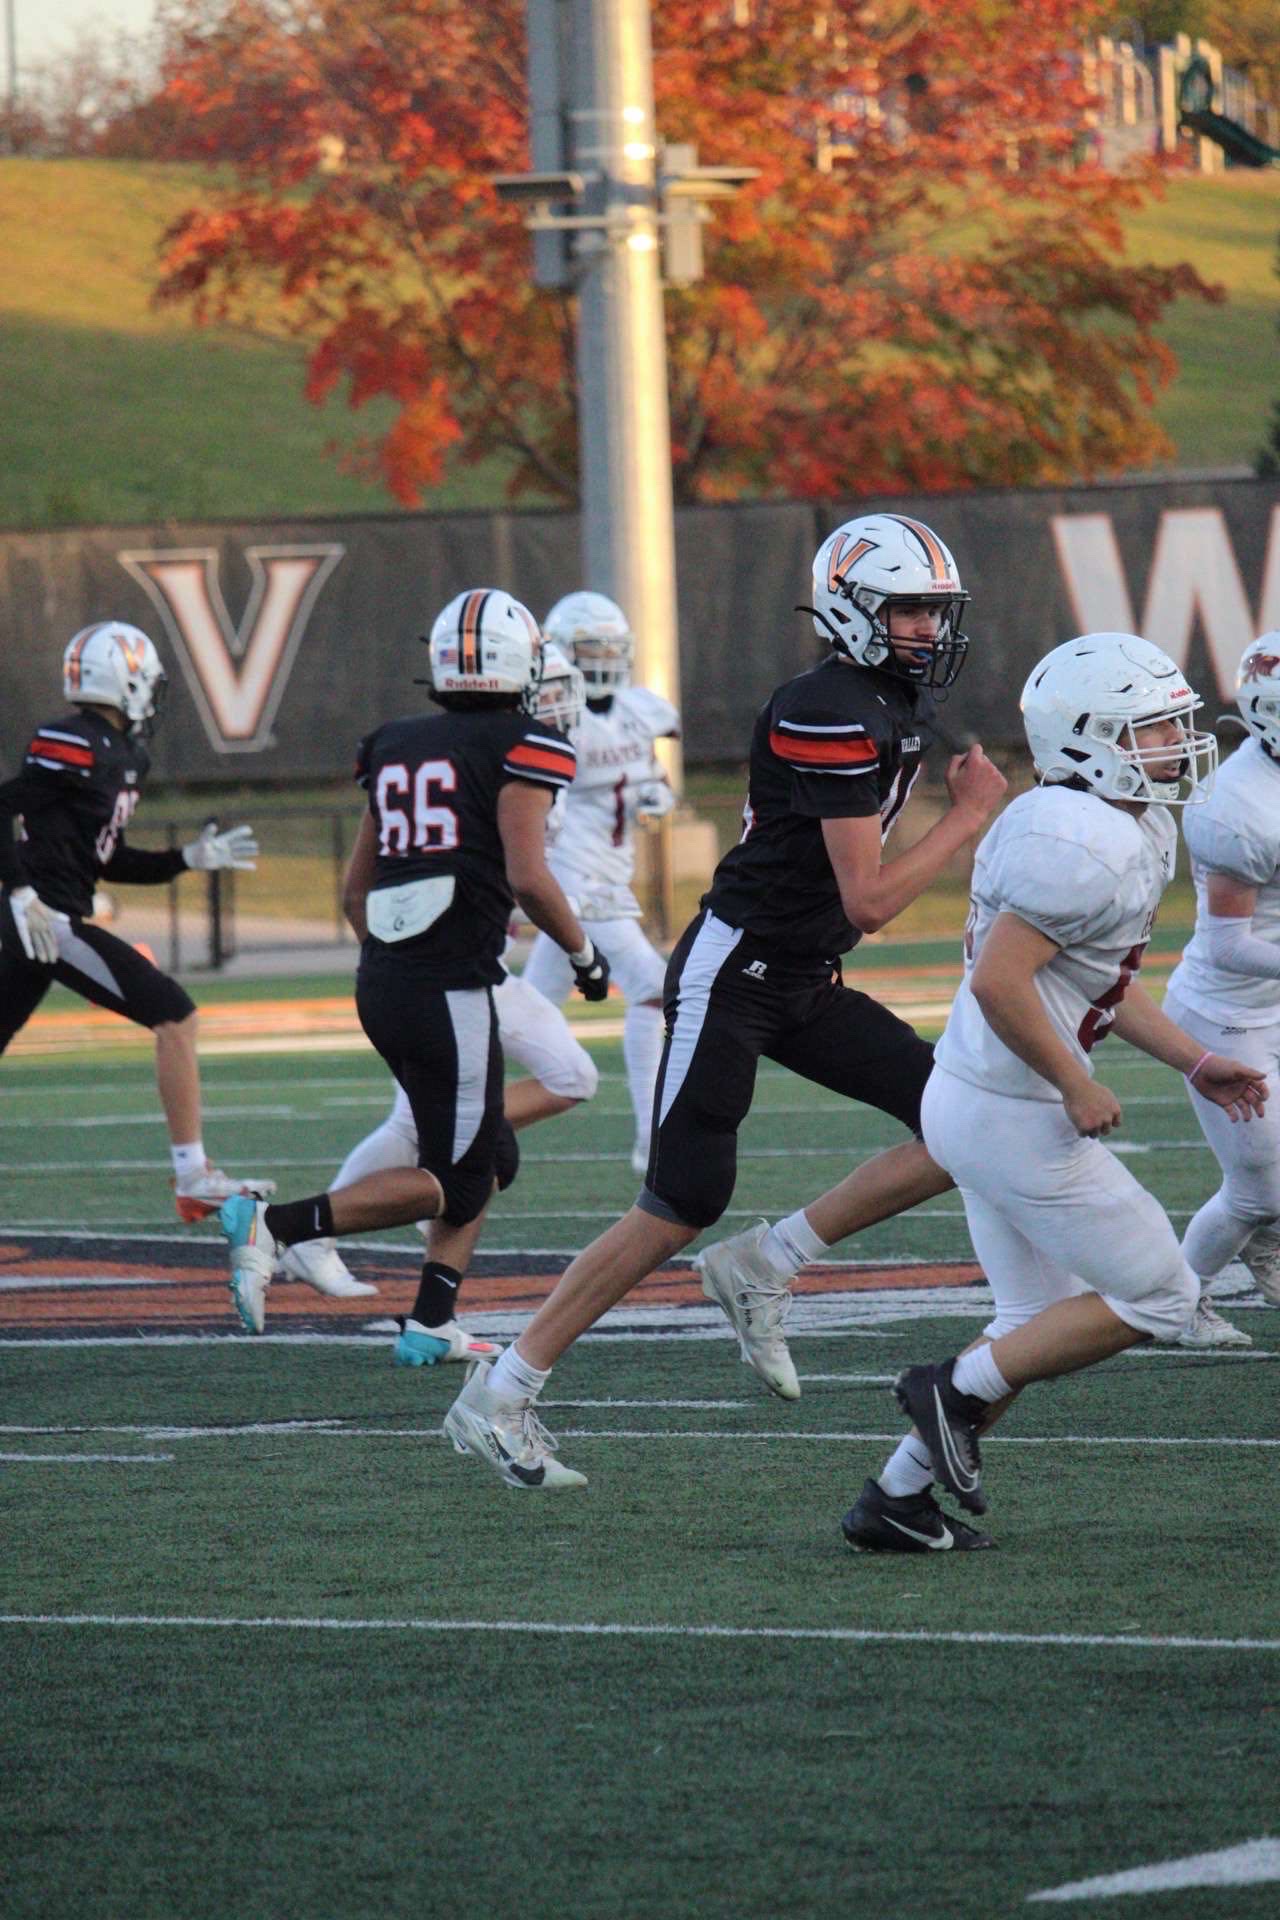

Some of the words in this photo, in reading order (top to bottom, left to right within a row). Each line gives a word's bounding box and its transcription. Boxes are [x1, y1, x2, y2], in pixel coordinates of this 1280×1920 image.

[828, 532, 881, 593] V
[112, 635, 145, 673] V
[118, 543, 346, 753] V
[444, 678, 499, 689] Riddell
[376, 759, 459, 857] 66
[611, 772, 628, 848] 1
